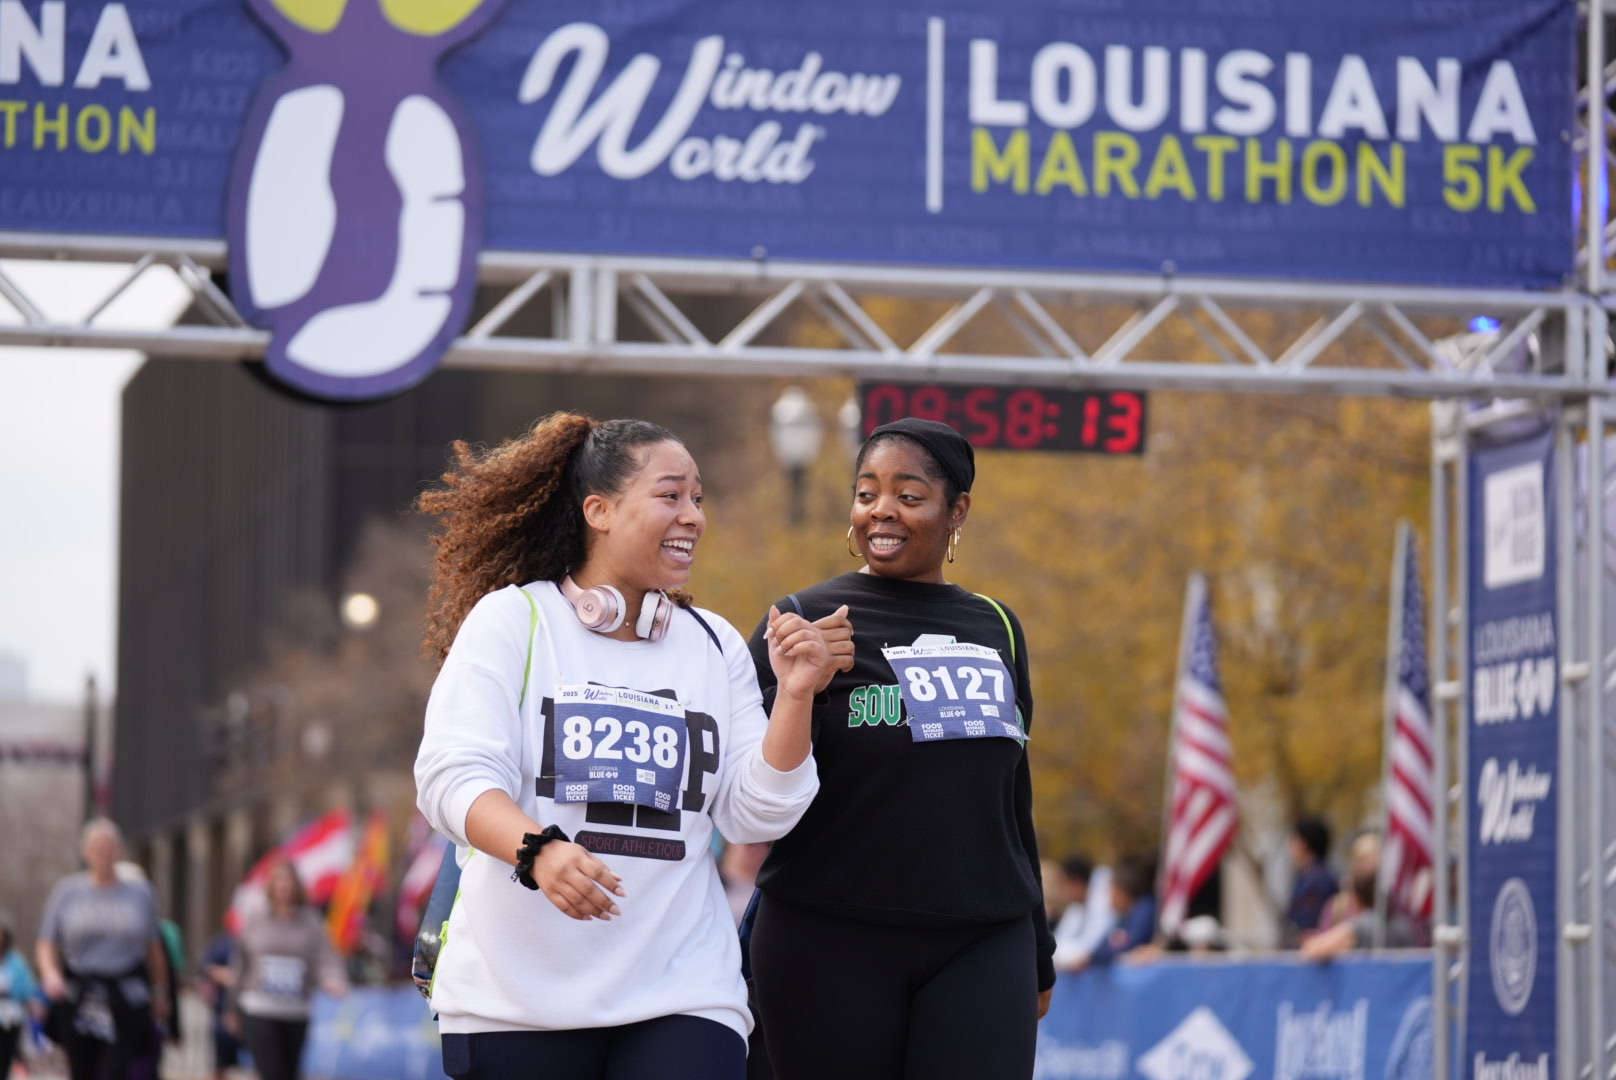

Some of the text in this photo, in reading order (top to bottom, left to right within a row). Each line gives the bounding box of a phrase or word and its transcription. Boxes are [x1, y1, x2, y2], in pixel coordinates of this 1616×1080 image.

[518, 21, 901, 181] Window
[969, 38, 1538, 145] LOUISIANA
[0, 100, 156, 155] THON
[971, 127, 1537, 213] MARATHON 5K
[904, 666, 1005, 703] 8127
[618, 692, 660, 706] LOUISIANA
[848, 685, 903, 728] SOU
[562, 715, 678, 769] 8238
[589, 771, 605, 779] BLUE
[613, 784, 635, 792] FOOD
[613, 794, 635, 802] TICKET
[655, 791, 671, 801] FOOD
[655, 802, 669, 811] TICKET
[581, 834, 620, 851] SPORT
